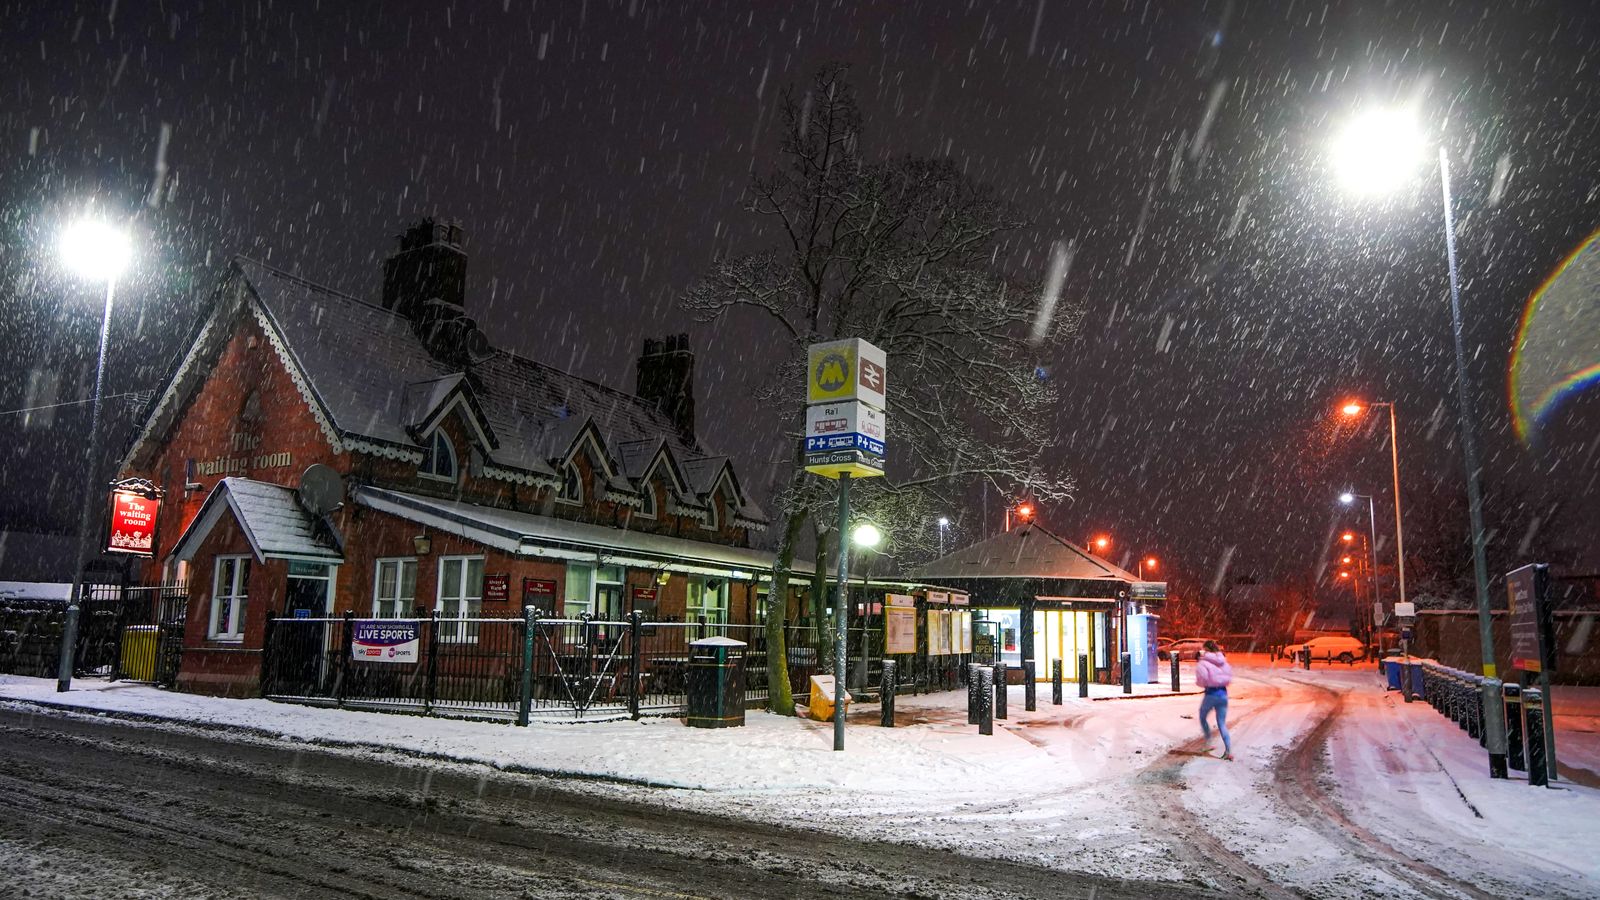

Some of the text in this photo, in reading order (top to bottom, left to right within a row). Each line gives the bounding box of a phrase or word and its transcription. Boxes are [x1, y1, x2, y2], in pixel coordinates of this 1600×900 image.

[232, 432, 260, 452] The
[196, 451, 292, 476] waiting room
[809, 454, 851, 464] Hunts Cross
[128, 502, 145, 511] The
[120, 510, 151, 522] waiting
[124, 518, 147, 527] room
[359, 630, 414, 639] LIVE SPORTS
[976, 645, 993, 654] OPEN
